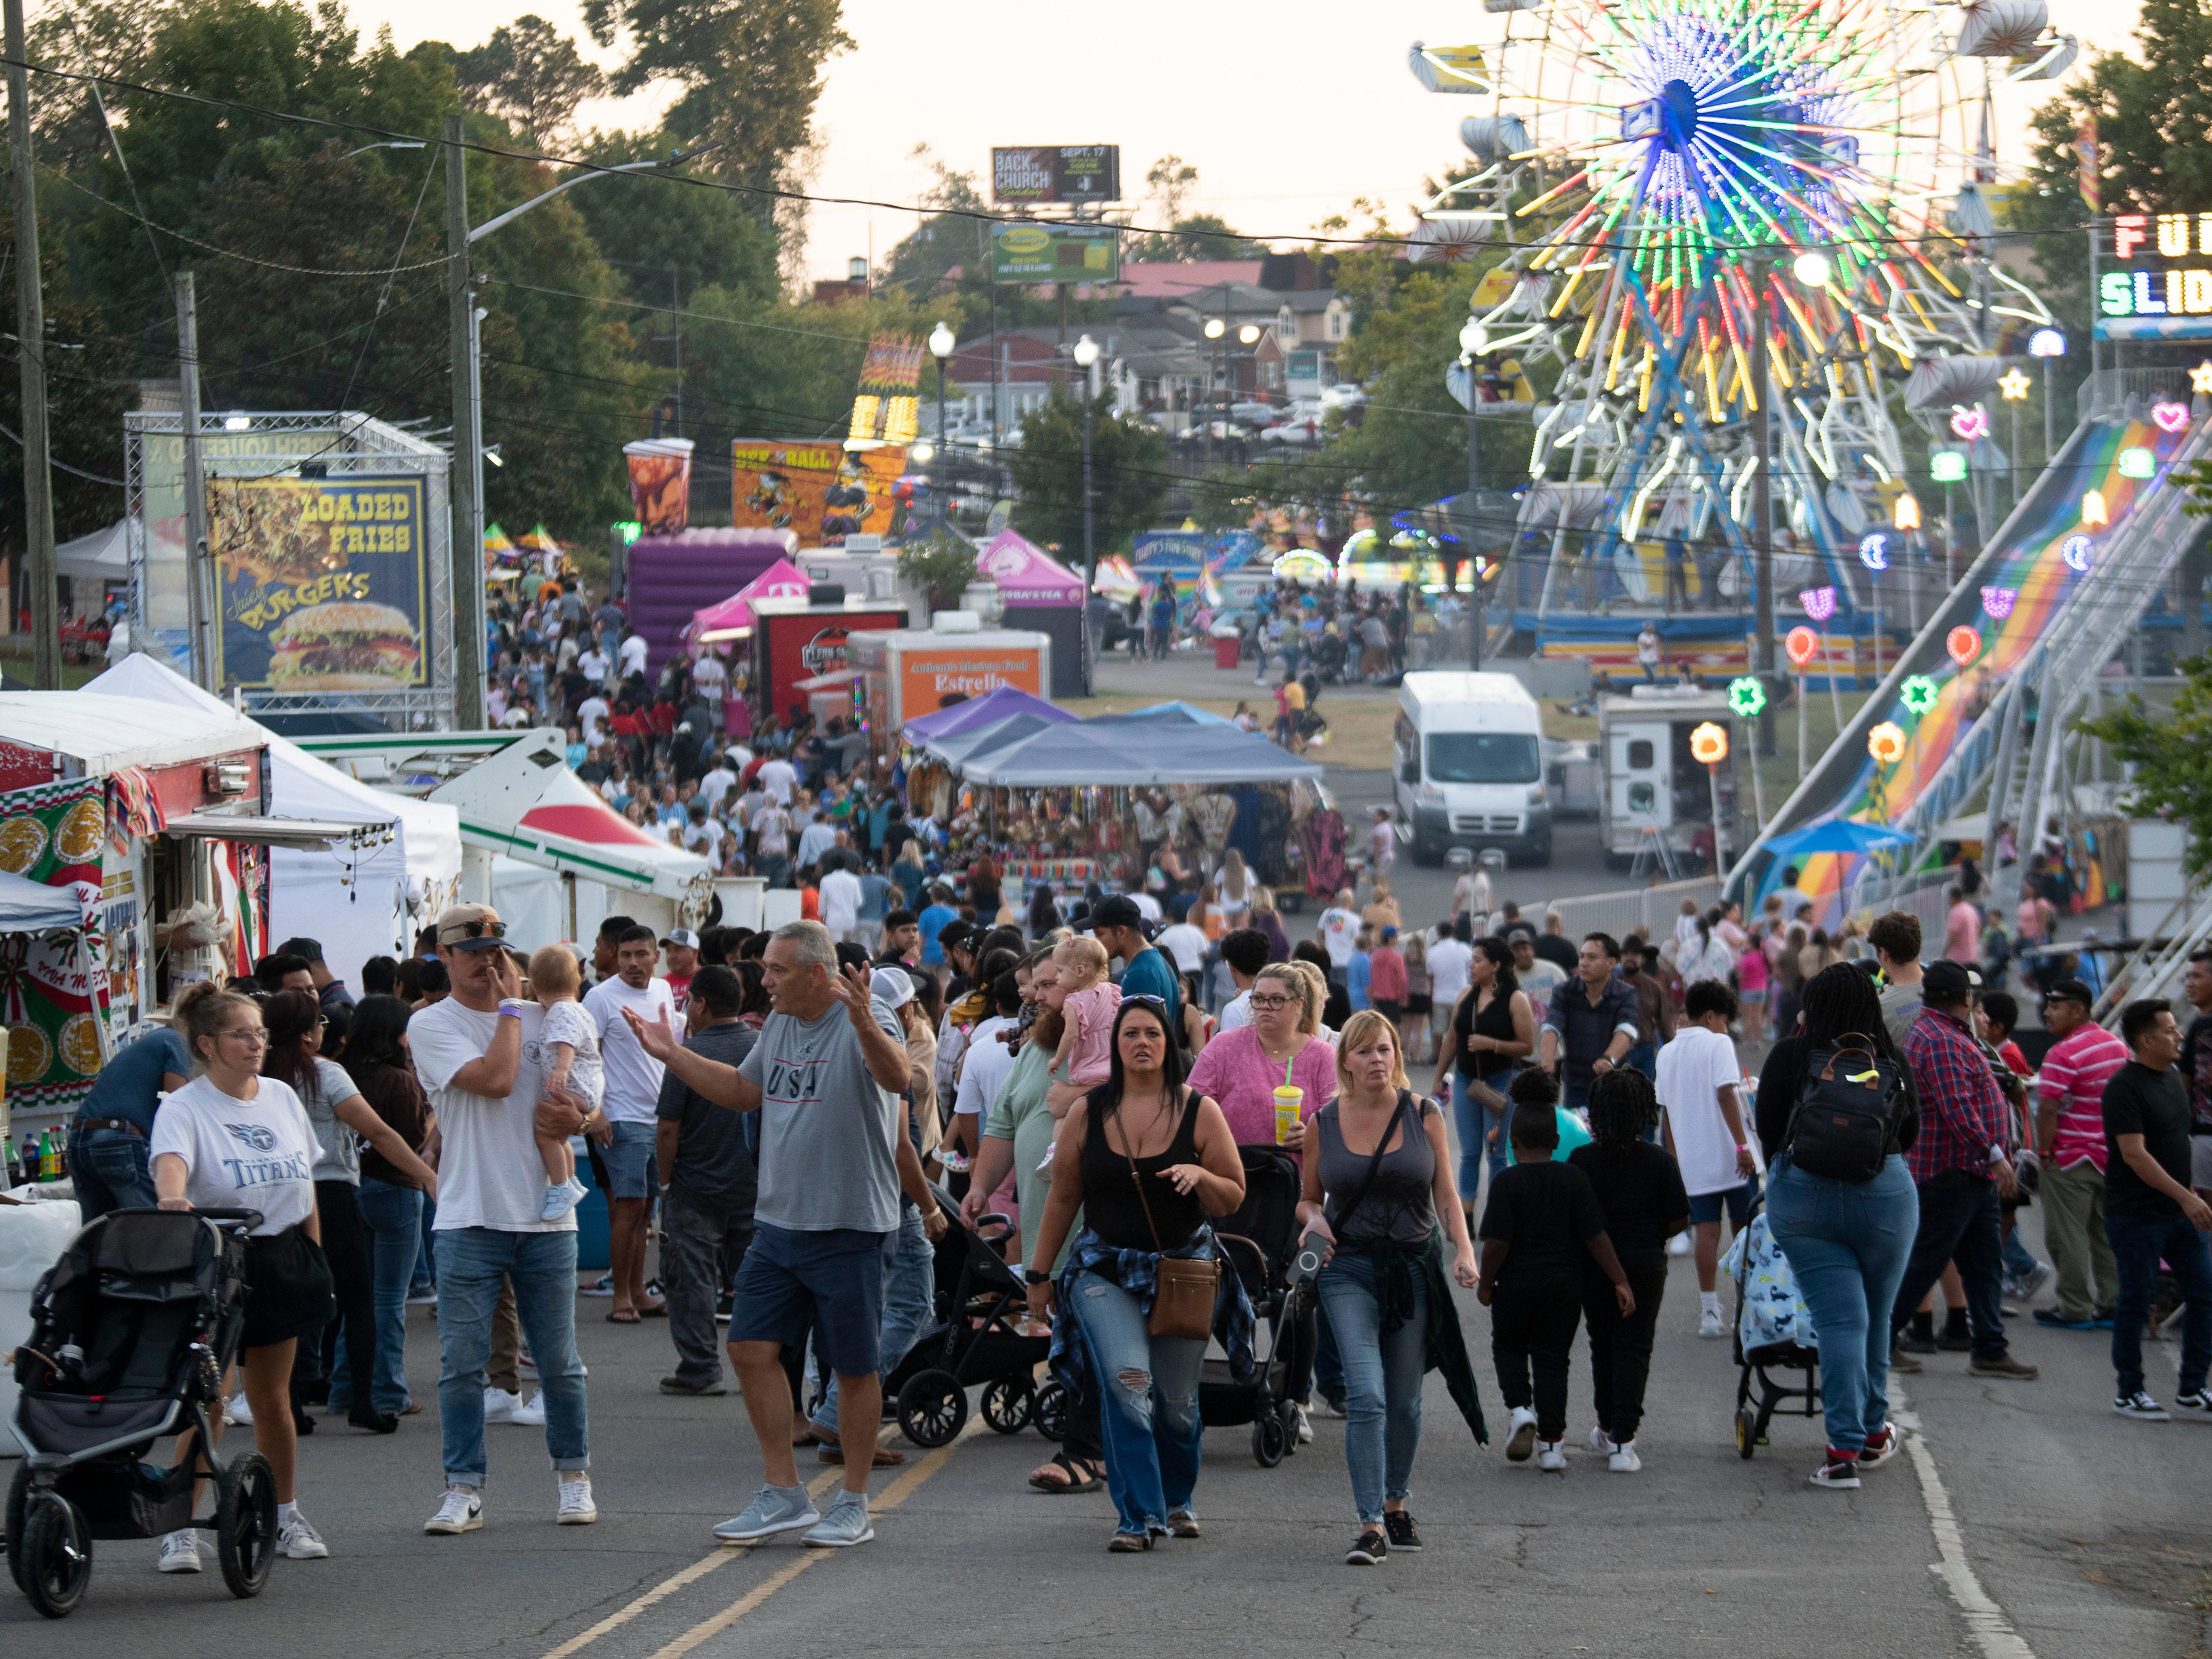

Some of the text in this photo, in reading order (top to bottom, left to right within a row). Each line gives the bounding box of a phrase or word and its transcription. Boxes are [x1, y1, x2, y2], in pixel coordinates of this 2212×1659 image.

[996, 154, 1031, 171] BACK
[1060, 147, 1105, 157] SEPT. 17
[996, 171, 1051, 188] CHURCH
[999, 184, 1044, 200] Sunday
[786, 449, 830, 470] BALL
[301, 494, 410, 521] LOADED
[329, 525, 409, 553] FRIES
[226, 587, 268, 622] Juicy
[238, 572, 371, 631] BURGERS
[1041, 589, 1061, 599] TEA
[910, 662, 957, 673] Authentic
[1003, 660, 1027, 670] Food
[37, 961, 66, 985] VIVA
[767, 1065, 817, 1099] USA
[222, 1150, 309, 1189] TITANS
[946, 1324, 958, 1355] corso
